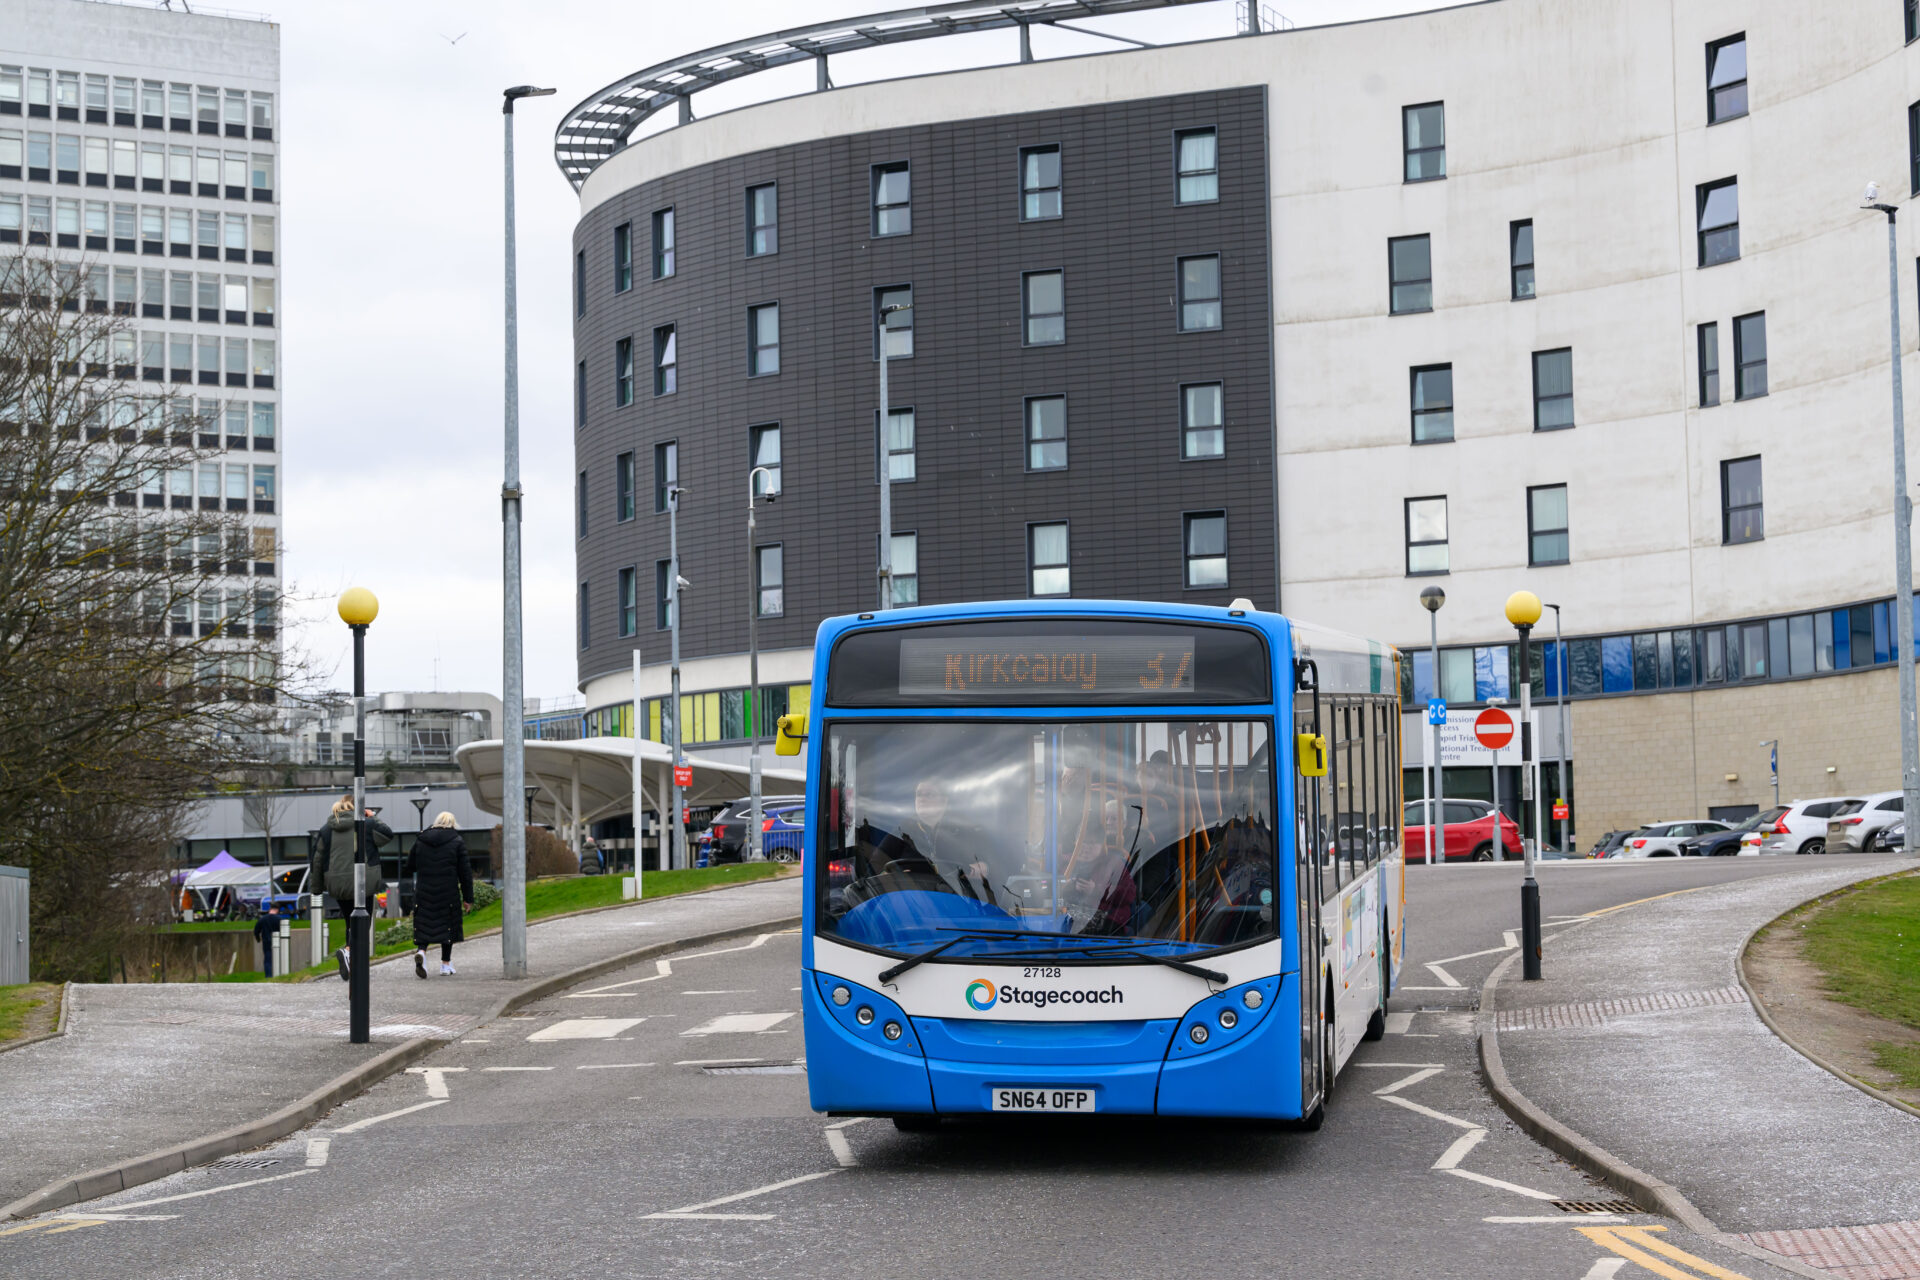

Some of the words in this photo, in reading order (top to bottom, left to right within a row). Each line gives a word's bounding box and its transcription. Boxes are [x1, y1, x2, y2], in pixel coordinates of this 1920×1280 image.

[945, 653, 1097, 690] Kirkcaldy
[1440, 735, 1457, 743] apid
[1459, 735, 1480, 743] Triag
[1023, 967, 1062, 978] 27128
[999, 985, 1123, 1008] Stagecoach
[1000, 1091, 1047, 1108] SN64
[1052, 1092, 1088, 1109] OFP
